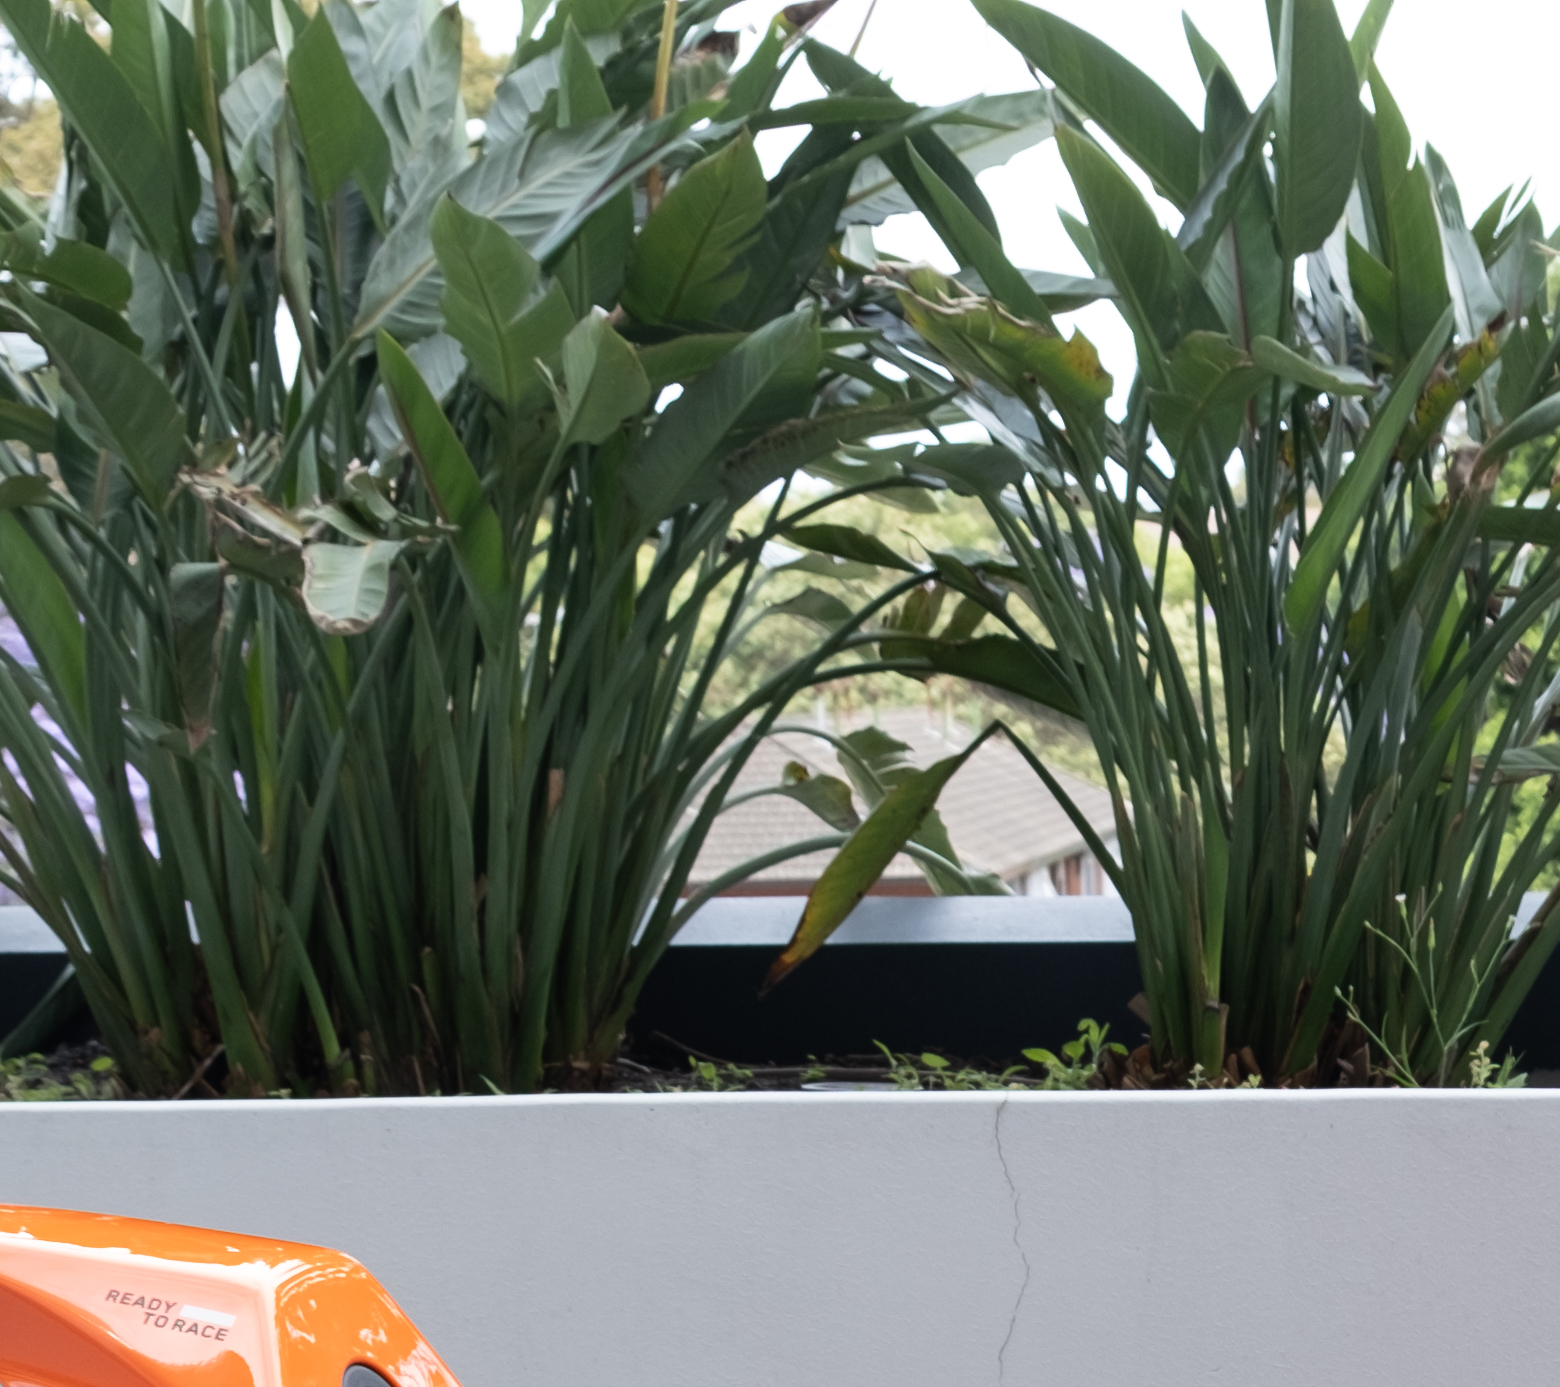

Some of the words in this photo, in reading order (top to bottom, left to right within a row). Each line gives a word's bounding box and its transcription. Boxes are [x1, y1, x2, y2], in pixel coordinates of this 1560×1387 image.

[105, 1289, 178, 1314] READY
[143, 1311, 169, 1329] TO
[171, 1318, 230, 1342] RACE
